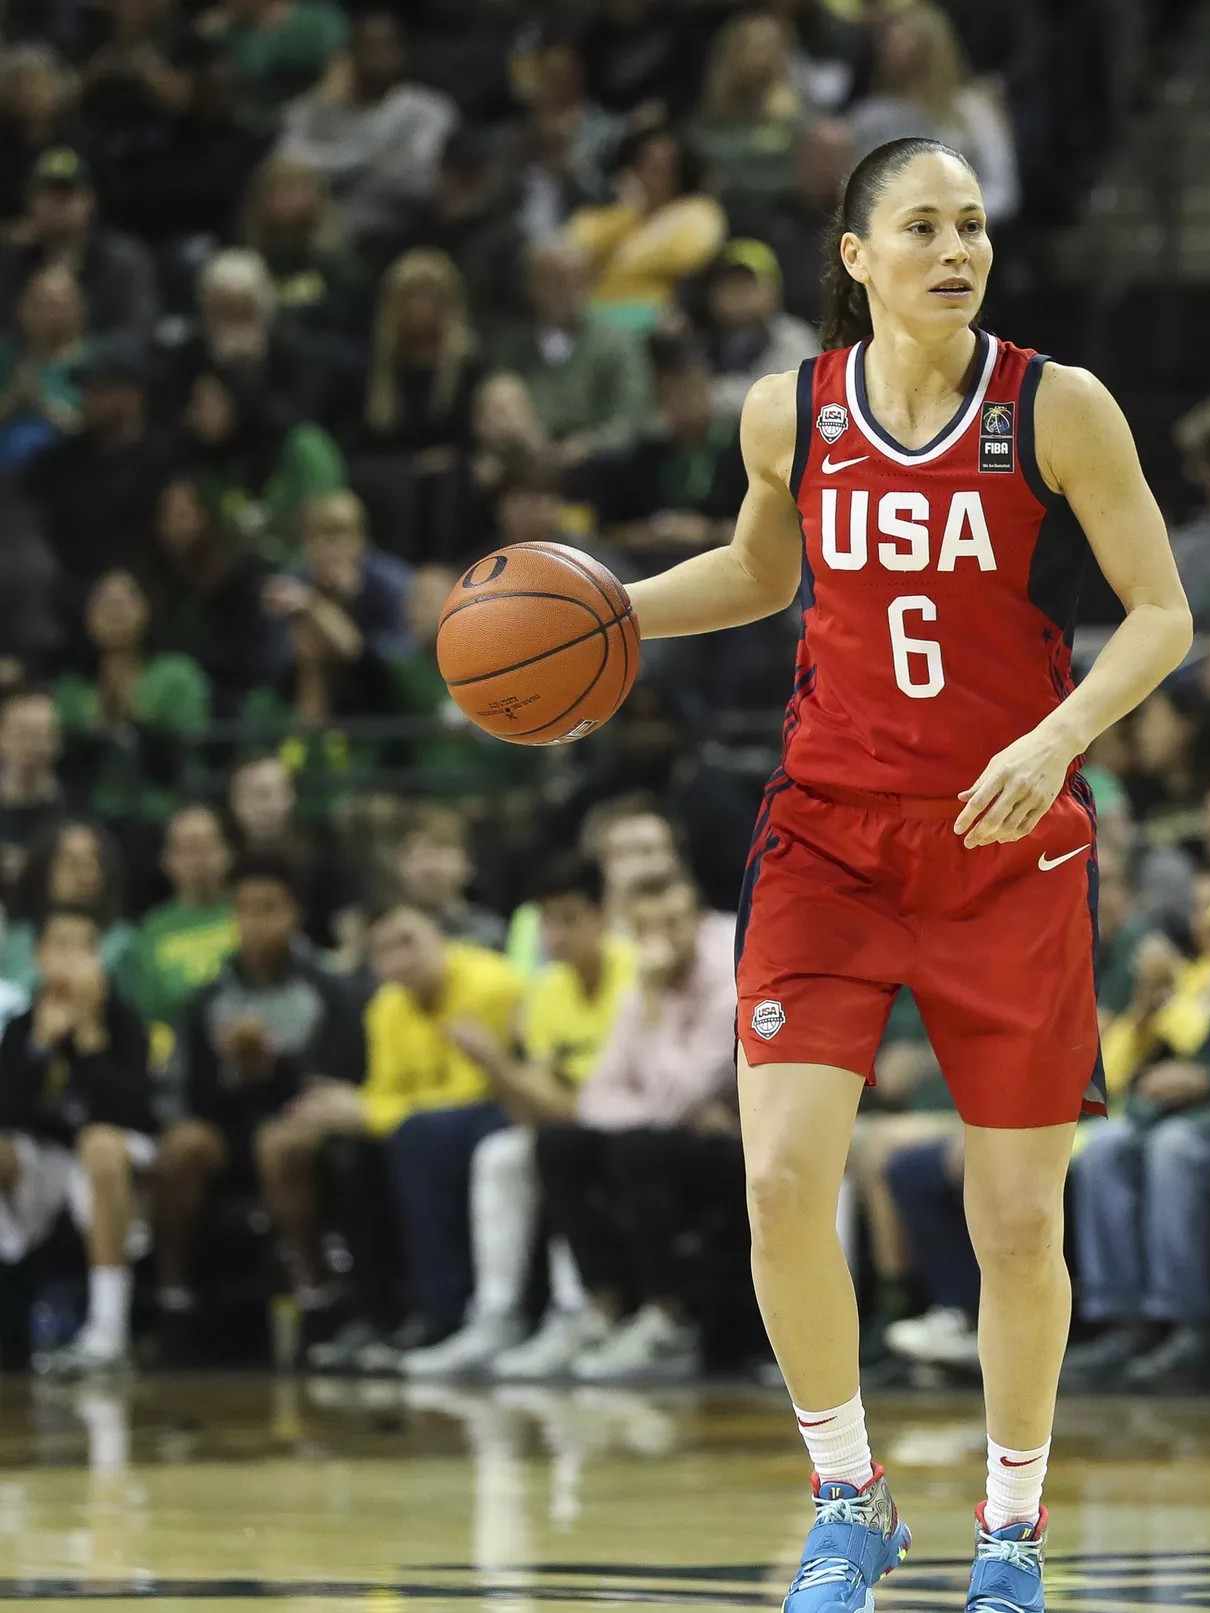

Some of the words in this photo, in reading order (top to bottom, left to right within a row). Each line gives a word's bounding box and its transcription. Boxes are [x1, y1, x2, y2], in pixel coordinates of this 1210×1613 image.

[984, 442, 1009, 455] FIBA
[821, 488, 998, 572] USA
[887, 595, 945, 699] 6
